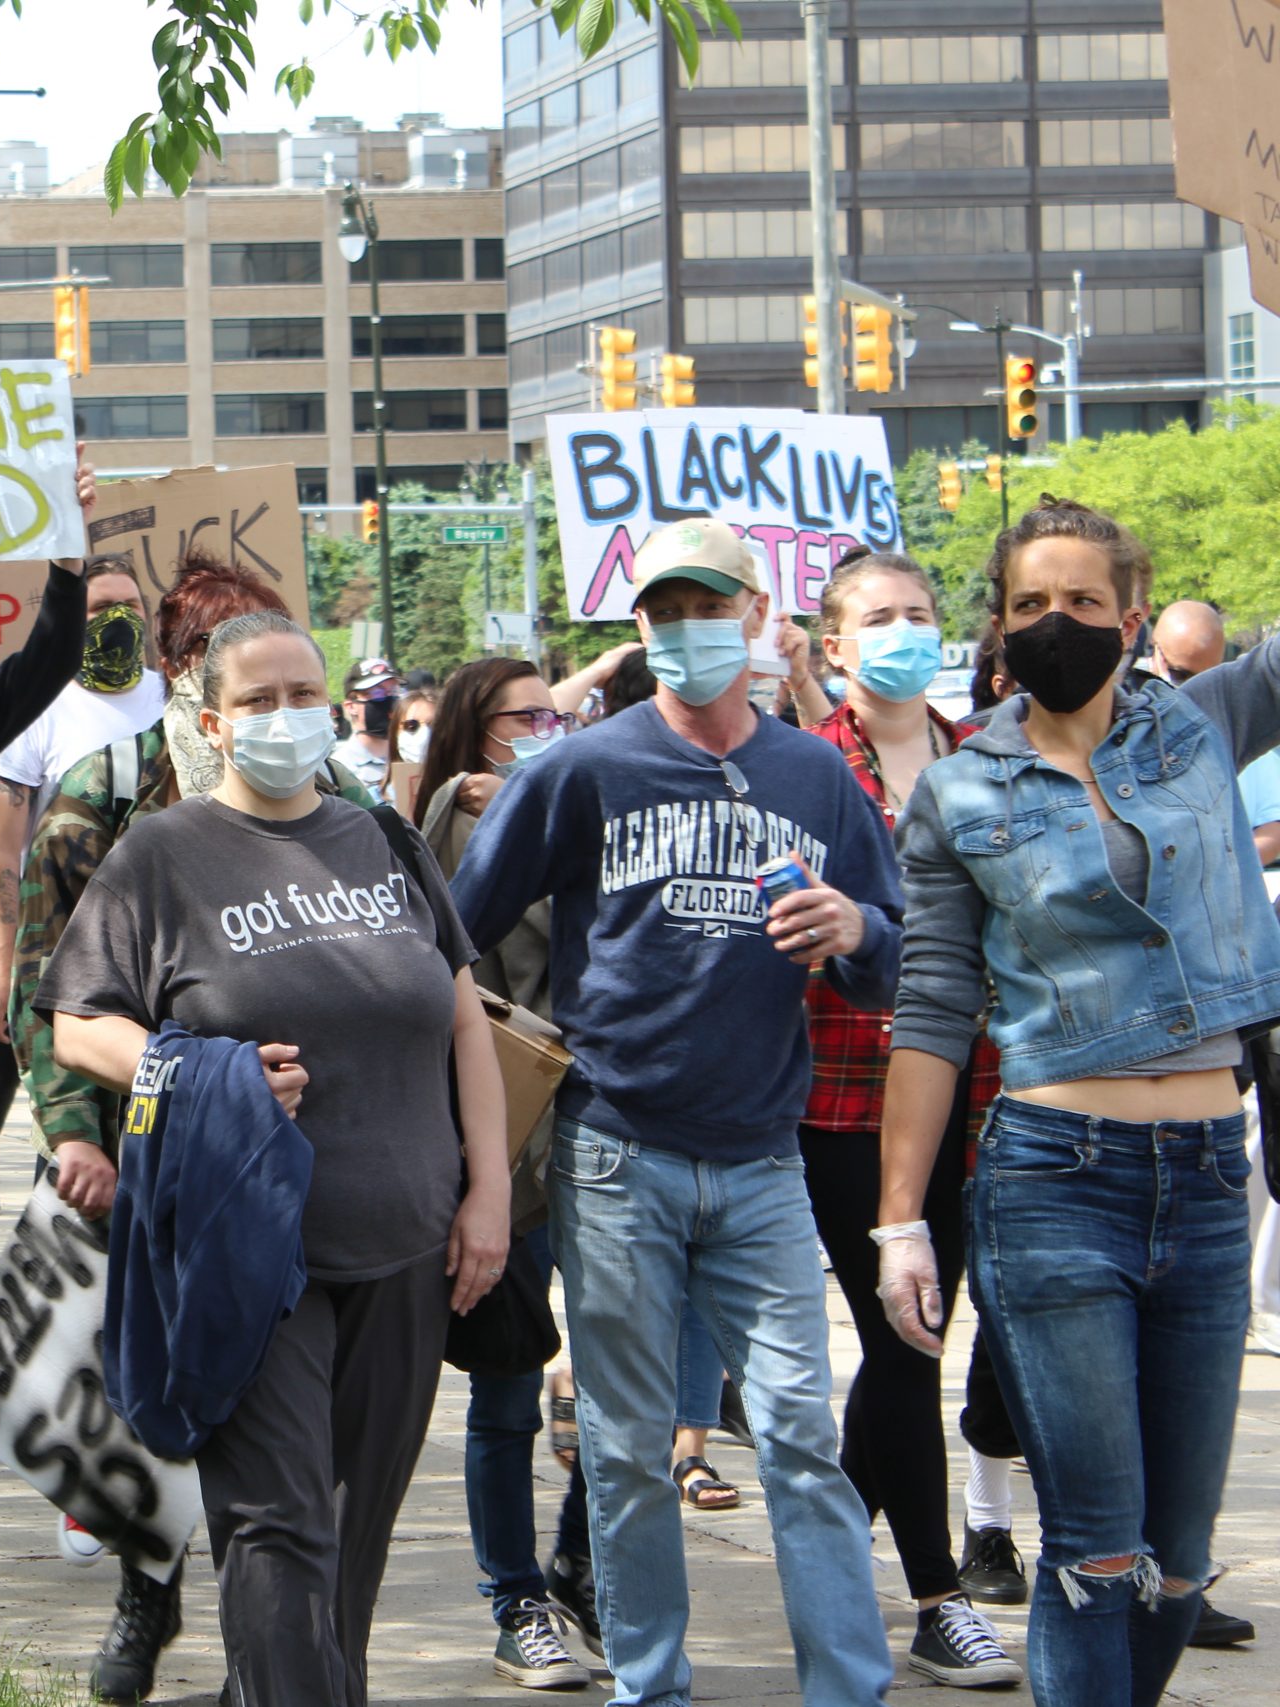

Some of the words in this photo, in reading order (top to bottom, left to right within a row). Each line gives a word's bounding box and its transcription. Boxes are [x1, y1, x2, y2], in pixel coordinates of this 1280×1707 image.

[570, 422, 786, 524] BLACK
[787, 443, 898, 553] LIVES
[602, 800, 766, 895] CLEARWATER
[220, 889, 291, 953] got
[287, 872, 412, 929] fudge?
[669, 884, 764, 918] FLORIDA
[250, 935, 313, 957] MACKINAC
[317, 930, 359, 942] ISLAND
